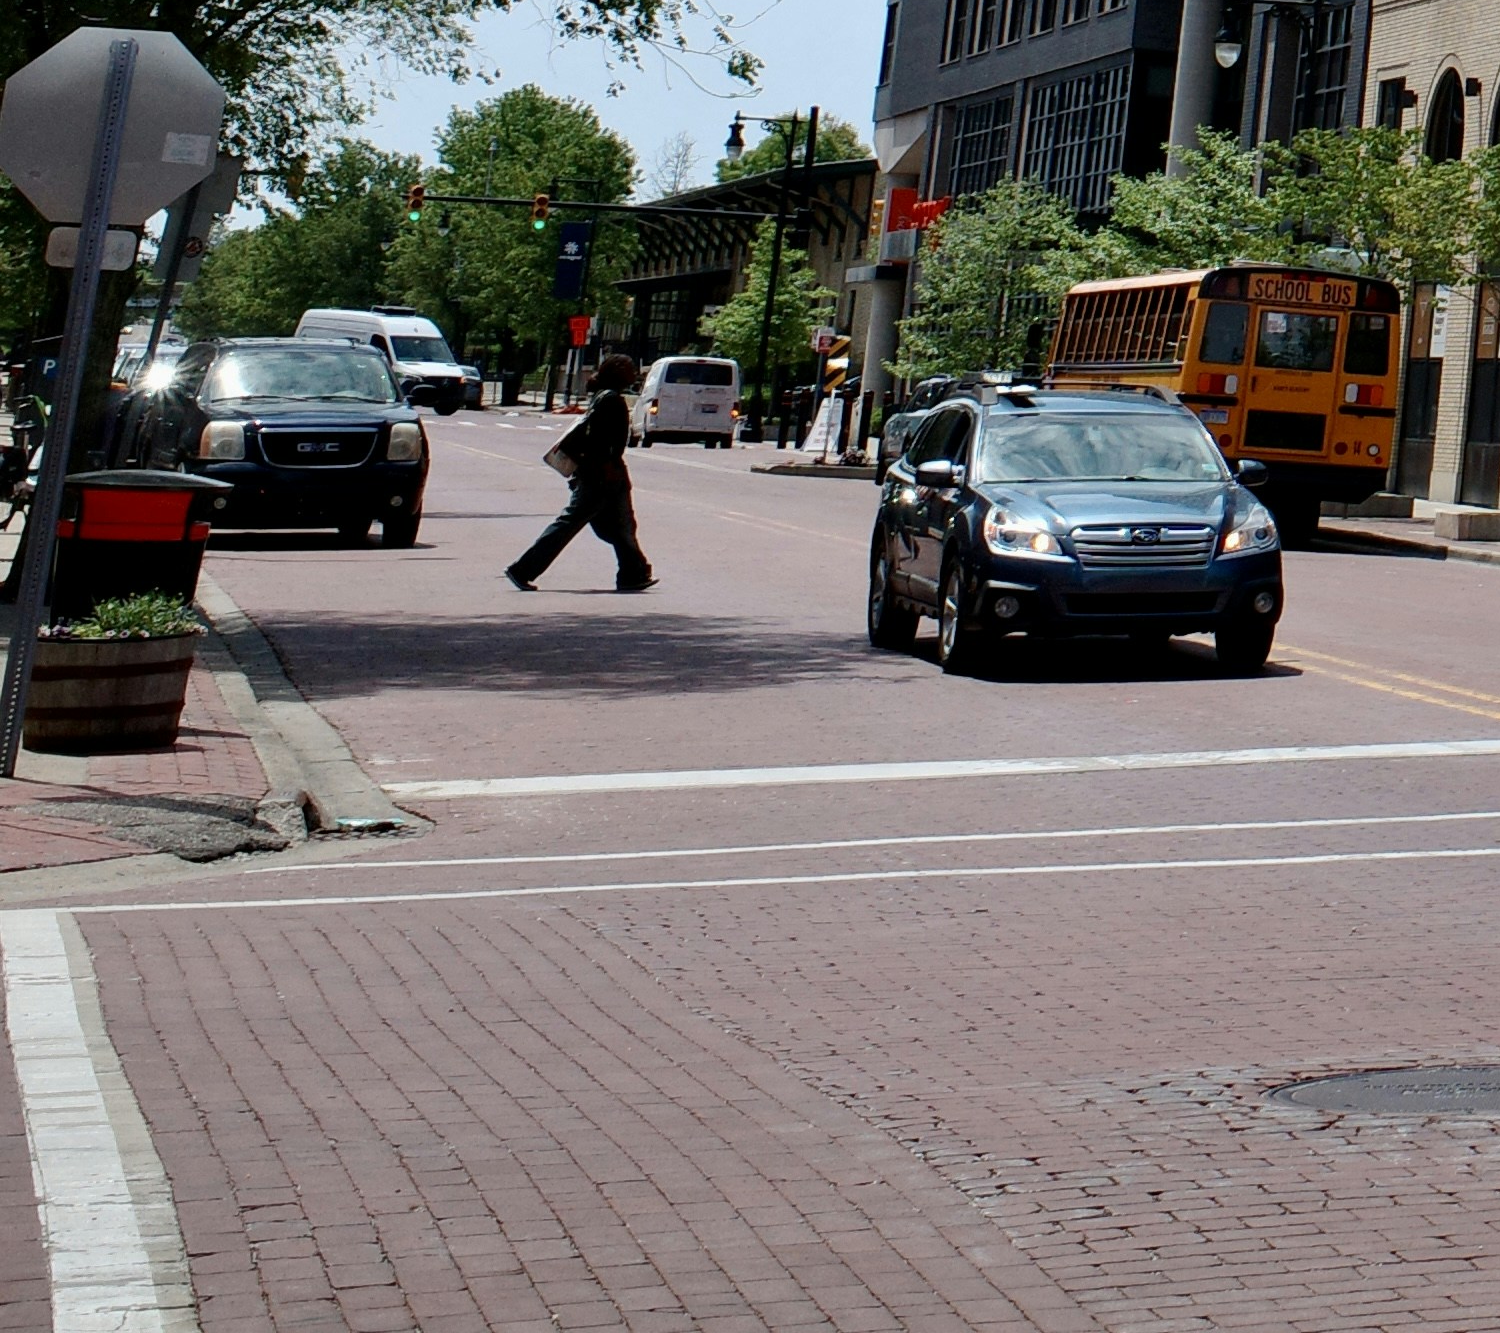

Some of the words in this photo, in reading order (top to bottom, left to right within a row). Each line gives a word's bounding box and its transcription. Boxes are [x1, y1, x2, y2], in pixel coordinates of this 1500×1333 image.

[1255, 278, 1312, 302] SCHOOL
[1322, 283, 1352, 304] BUS
[43, 360, 56, 375] P
[297, 442, 340, 452] GMC
